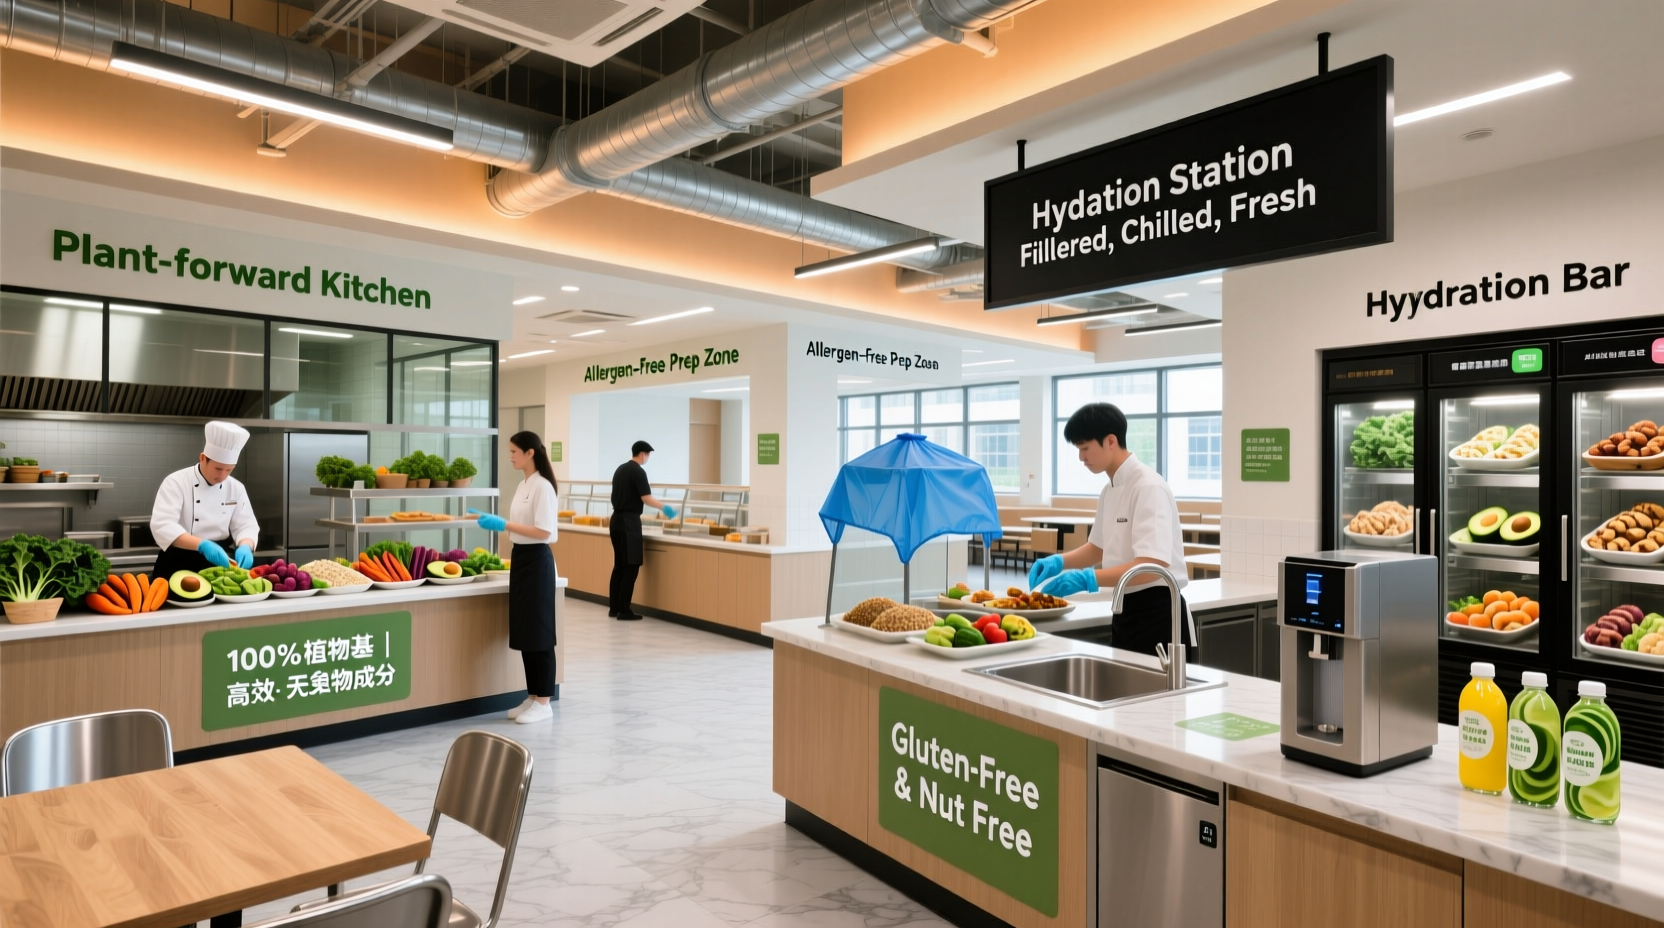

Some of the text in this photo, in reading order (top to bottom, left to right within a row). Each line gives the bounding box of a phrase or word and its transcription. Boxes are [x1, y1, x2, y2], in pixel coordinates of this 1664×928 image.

[1032, 142, 1294, 233] Hydation Station
[1121, 199, 1221, 246] Chilled,
[1230, 178, 1316, 223] Fresh
[52, 229, 431, 309] Plant-forward Kitchen
[1563, 262, 1630, 293] Bar
[670, 352, 700, 374] Prep
[703, 347, 739, 367] Zone
[890, 351, 912, 371] Pep
[891, 721, 1040, 810] Gluten-Free
[894, 766, 1033, 858] & Nut Free
